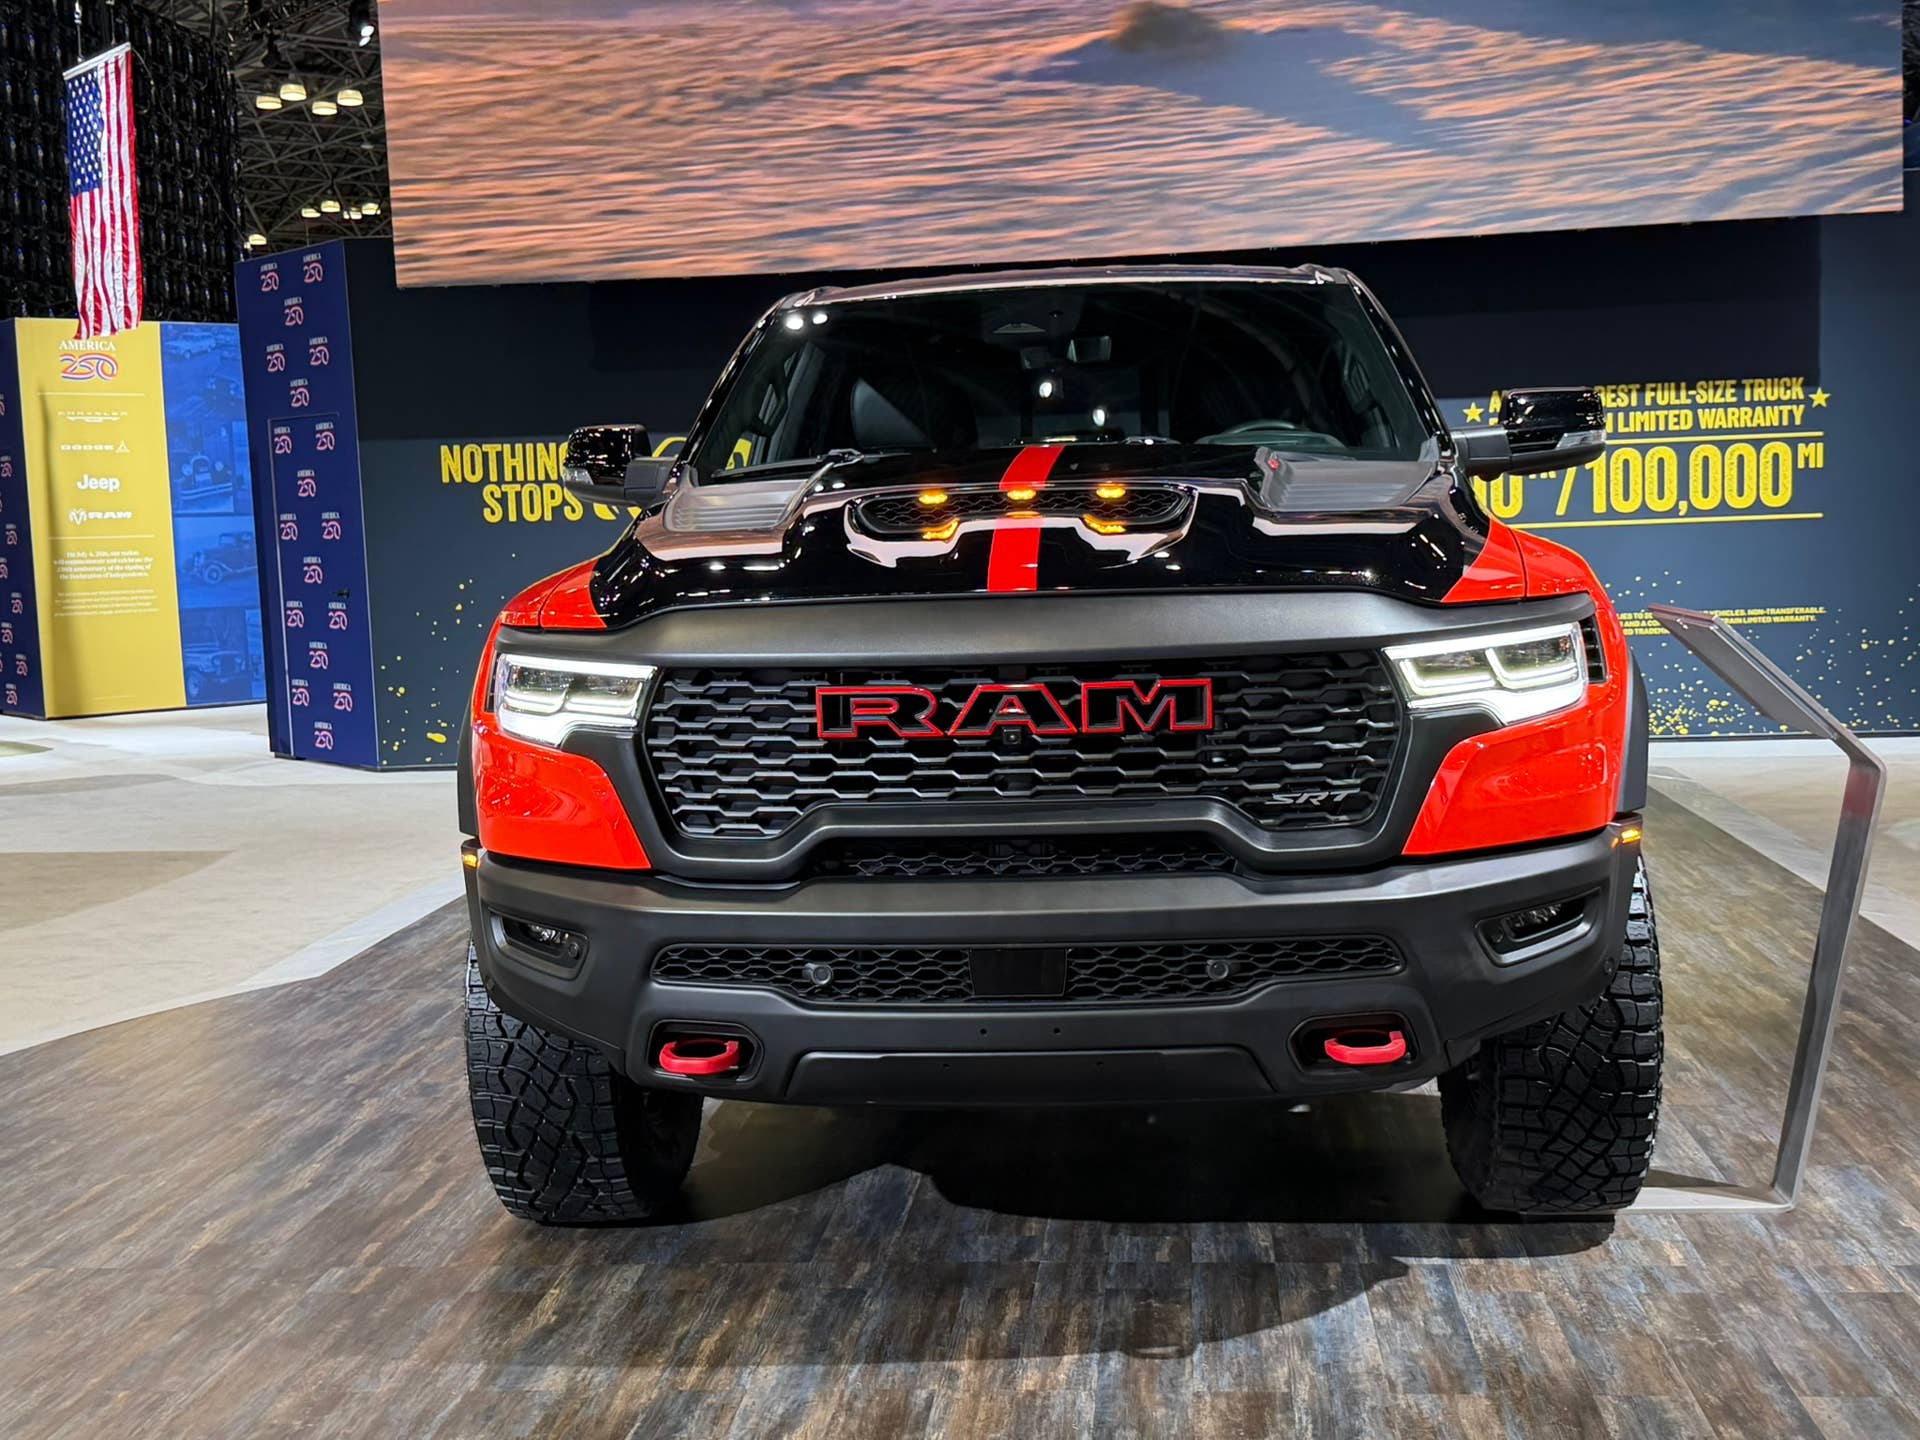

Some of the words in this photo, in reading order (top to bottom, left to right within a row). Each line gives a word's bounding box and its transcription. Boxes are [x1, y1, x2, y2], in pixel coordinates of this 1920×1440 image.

[59, 340, 116, 351] AMERICA
[60, 352, 119, 381] 250
[1645, 380, 1737, 406] FULL-SIZE
[1742, 377, 1805, 402] TRUCK
[1617, 409, 1693, 433] LIMITED
[1697, 405, 1805, 429] WARRANTY
[440, 442, 568, 483] NOTHIN
[1797, 442, 1824, 468] MI
[77, 474, 121, 492] Jeep
[815, 677, 1212, 738] RAM
[1264, 788, 1361, 805] SRT
